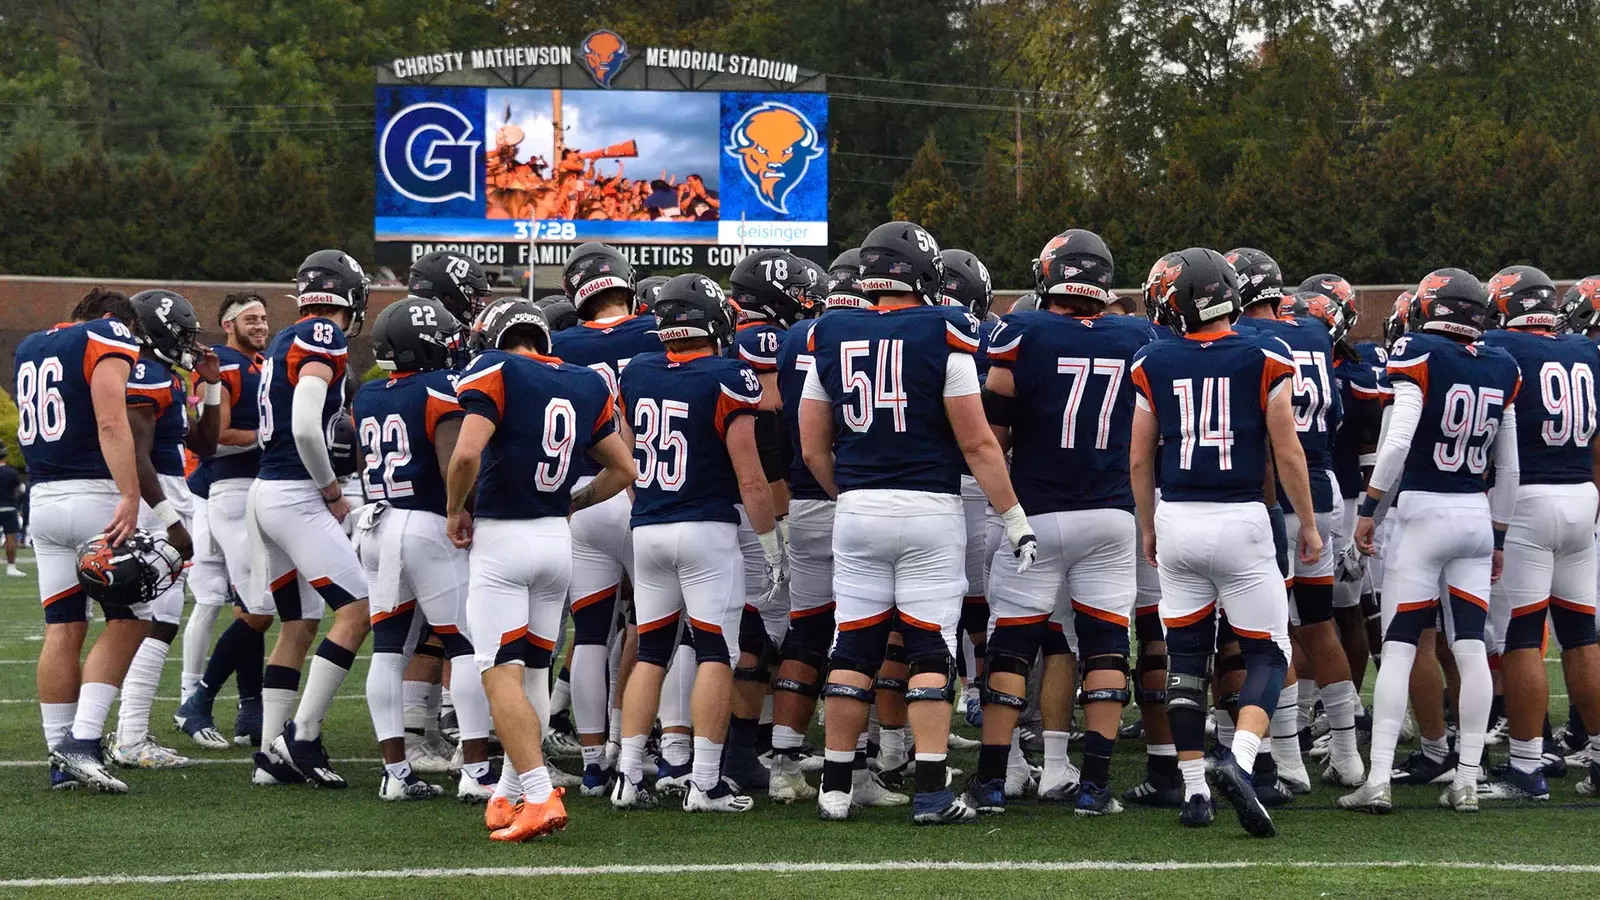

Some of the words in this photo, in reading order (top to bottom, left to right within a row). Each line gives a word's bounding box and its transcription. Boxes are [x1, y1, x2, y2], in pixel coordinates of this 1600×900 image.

[393, 52, 463, 78] CHRISTY
[471, 46, 571, 69] MATHEWSON
[646, 48, 725, 73] MEMORIAL
[729, 55, 798, 83] STADIUM
[513, 222, 577, 240] 37:28
[737, 225, 809, 242] Geisinger
[520, 245, 574, 264] FAMIL
[616, 246, 693, 266] HLETICS
[446, 256, 470, 278] 79
[760, 260, 788, 281] 78
[579, 278, 614, 298] Riddell
[863, 281, 893, 289] Riddell
[1065, 285, 1101, 297] Riddell
[159, 298, 173, 316] 3
[301, 295, 333, 303] Riddell
[828, 298, 860, 306] Riddell
[409, 305, 438, 326] 22
[313, 322, 334, 344] 83
[660, 328, 689, 340] Riddell
[1443, 323, 1474, 335] Riddell
[757, 332, 778, 352] 78
[135, 363, 146, 380] 3
[840, 339, 908, 433] 54
[1292, 351, 1332, 432] 51
[17, 356, 67, 446] 86
[1057, 357, 1126, 450] 77
[1539, 362, 1597, 448] 90
[1172, 377, 1235, 471] 14
[1432, 383, 1504, 474] 95
[534, 397, 576, 492] 9
[634, 398, 689, 492] 35
[359, 413, 415, 499] 22
